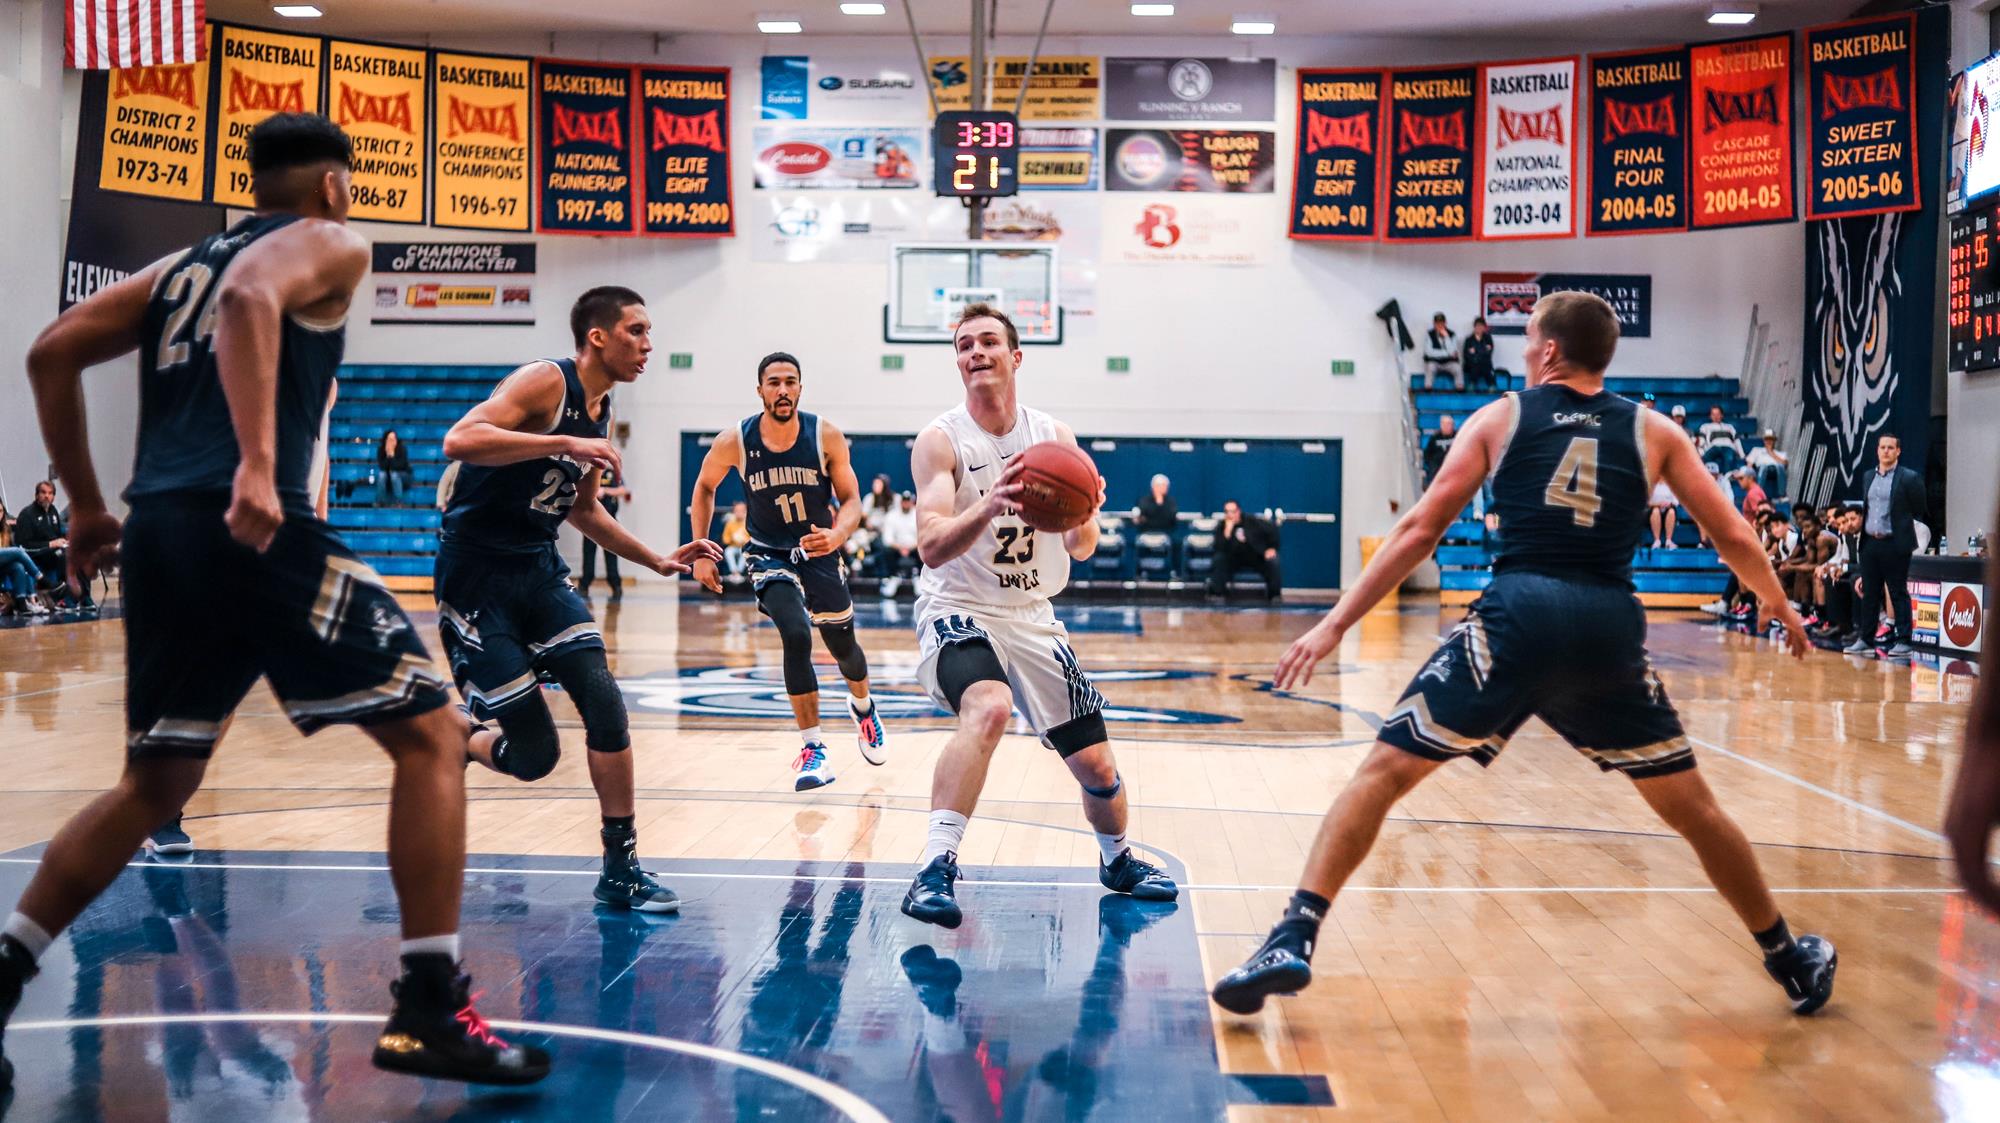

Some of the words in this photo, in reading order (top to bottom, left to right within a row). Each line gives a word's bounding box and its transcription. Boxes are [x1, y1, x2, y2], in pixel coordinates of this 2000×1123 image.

[224, 39, 316, 68] BASKETBALL
[1813, 29, 1907, 63] BASKETBALL
[334, 53, 422, 80] BASKETBALL
[1005, 62, 1091, 75] MECHANIC
[1596, 61, 1682, 87] BASKETBALL
[1695, 48, 1785, 77] BASKETBALL
[114, 65, 199, 111] NAIA
[439, 64, 526, 90] BASKETBALL
[544, 74, 626, 97] BASKETBALL
[849, 79, 914, 89] SUBARU
[1490, 72, 1569, 95] BASKETBALL
[227, 67, 305, 115] NAIA
[645, 79, 726, 99] BASKETBALL
[1303, 82, 1378, 101] BASKETBALL
[1393, 79, 1472, 100] BASKETBALL
[1821, 64, 1905, 121] NAIA
[116, 106, 181, 131] DISTRICT
[185, 116, 197, 132] 2
[338, 81, 415, 135] NAIA
[446, 94, 523, 144] NAIA
[1602, 93, 1678, 144] NAIA
[1703, 82, 1781, 134] NAIA
[552, 102, 623, 150] NAIA
[653, 106, 725, 153] NAIA
[957, 121, 1014, 147] 3:39
[1306, 108, 1372, 154] NAIA
[1398, 108, 1467, 154] NAIA
[1496, 103, 1567, 150] NAIA
[1827, 119, 1896, 144] SWEET
[110, 128, 199, 155] CHAMPIONS
[351, 136, 400, 155] ISTRICT
[404, 140, 414, 157] 2
[439, 142, 525, 162] CONFERENCE
[1203, 136, 1260, 151] LAUGH
[1713, 134, 1770, 152] CASCADE
[555, 153, 621, 171] NATIONAL
[666, 157, 708, 174] ELITE
[1210, 153, 1253, 168] PLAY
[1495, 155, 1563, 172] NATIONAL
[1613, 146, 1665, 166] FINAL
[1700, 148, 1782, 168] CONFERENCE
[1821, 142, 1902, 168] SIXTEEN
[117, 157, 188, 186] 1973-74
[350, 157, 418, 178] AMPIONS
[442, 161, 523, 180] CHAMPIONS
[953, 154, 999, 191] 21
[1316, 159, 1357, 176] ELITE
[1403, 158, 1461, 176] SWEET
[1615, 168, 1664, 187] FOUR
[1704, 164, 1779, 182] CHAMPIONS
[549, 173, 627, 192] RUNNER-UP
[665, 177, 709, 194] EIGHT
[1313, 179, 1356, 196] EIGHT
[1396, 179, 1464, 197] SIXTEEN
[1488, 175, 1569, 193] CHAMPIONS
[1821, 170, 1903, 203] 2005-06
[350, 185, 408, 208] 986-87
[450, 194, 517, 217] 1996-97
[1601, 194, 1676, 222] 2004-05
[1704, 185, 1780, 214] 2004-05
[557, 199, 624, 223] 1997-98
[648, 202, 729, 224] 1999-2000
[1302, 205, 1367, 227] 2000-01
[1395, 205, 1465, 228] 2002-03
[1493, 202, 1561, 225] 2003-04
[406, 245, 503, 258] CHAMPIONS
[392, 257, 414, 271] OF
[418, 257, 517, 271] CHARACTER
[749, 470, 768, 492] CAL
[768, 466, 819, 487] MARITIME
[1545, 436, 1602, 527] 4
[774, 492, 807, 524] 11
[993, 526, 1035, 564] 23
[1948, 601, 1976, 631] Coastal
